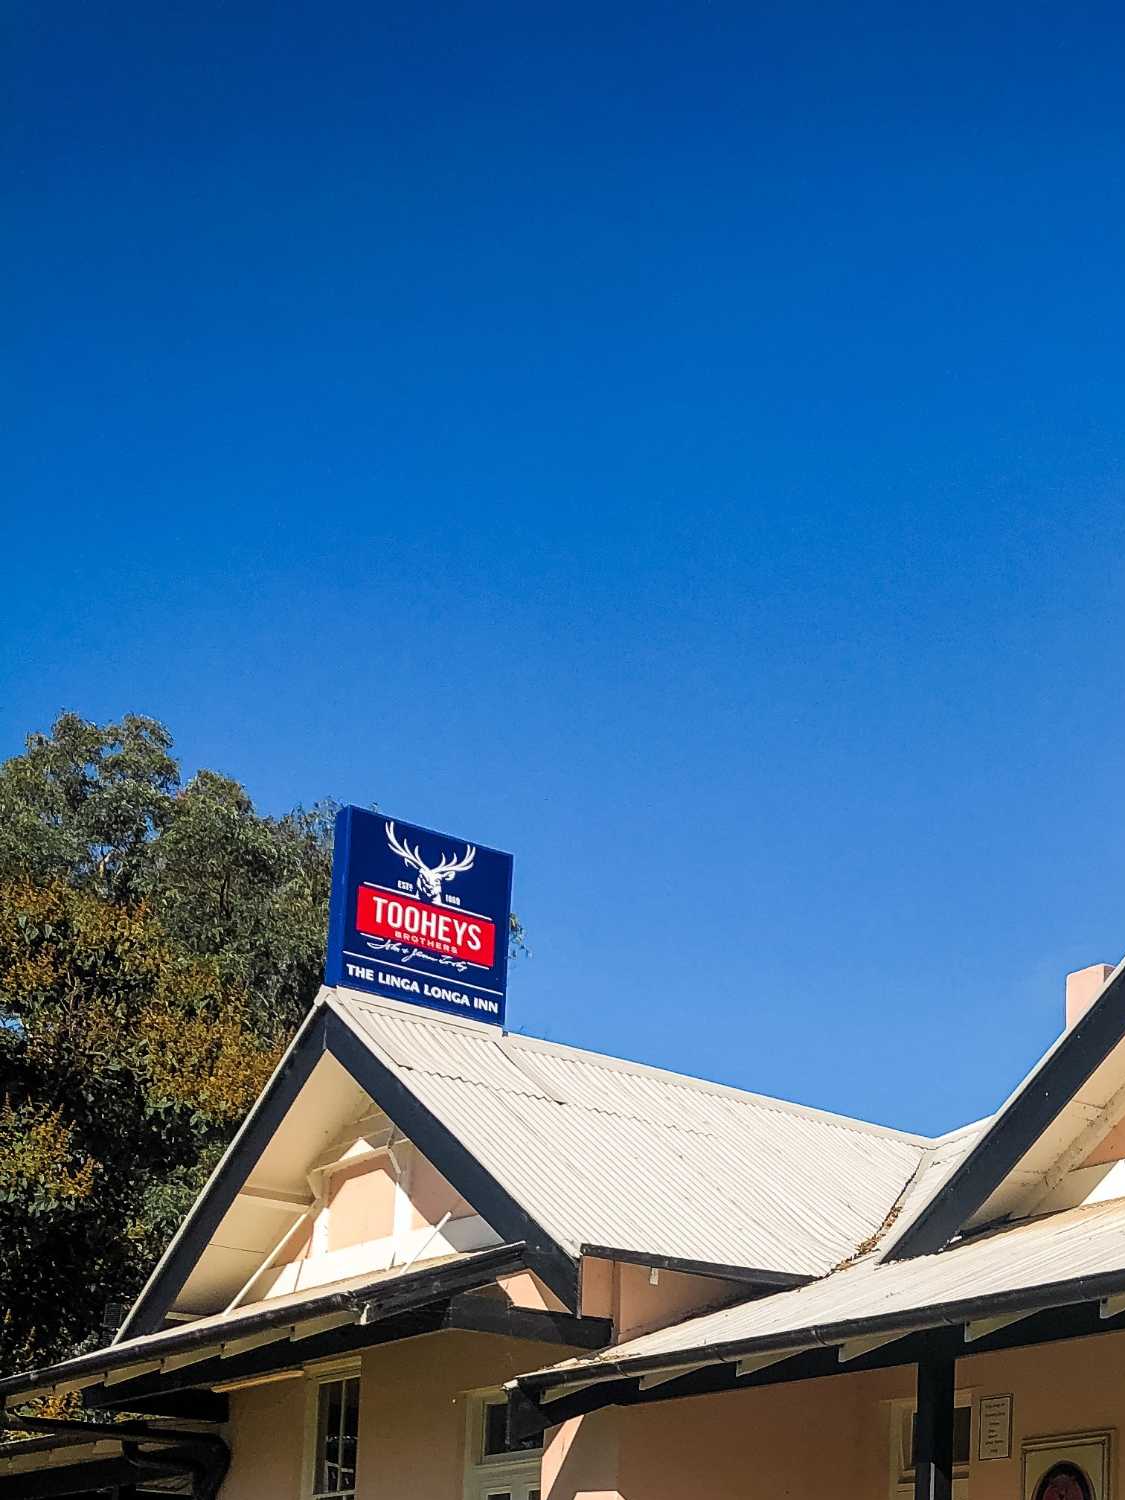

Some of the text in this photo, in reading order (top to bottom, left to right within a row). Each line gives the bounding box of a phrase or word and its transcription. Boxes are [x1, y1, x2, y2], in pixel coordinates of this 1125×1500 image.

[373, 896, 482, 951] TOOHEYS
[394, 931, 458, 955] BROTHERS
[346, 963, 498, 1014] THE LINGA LONGA INN
